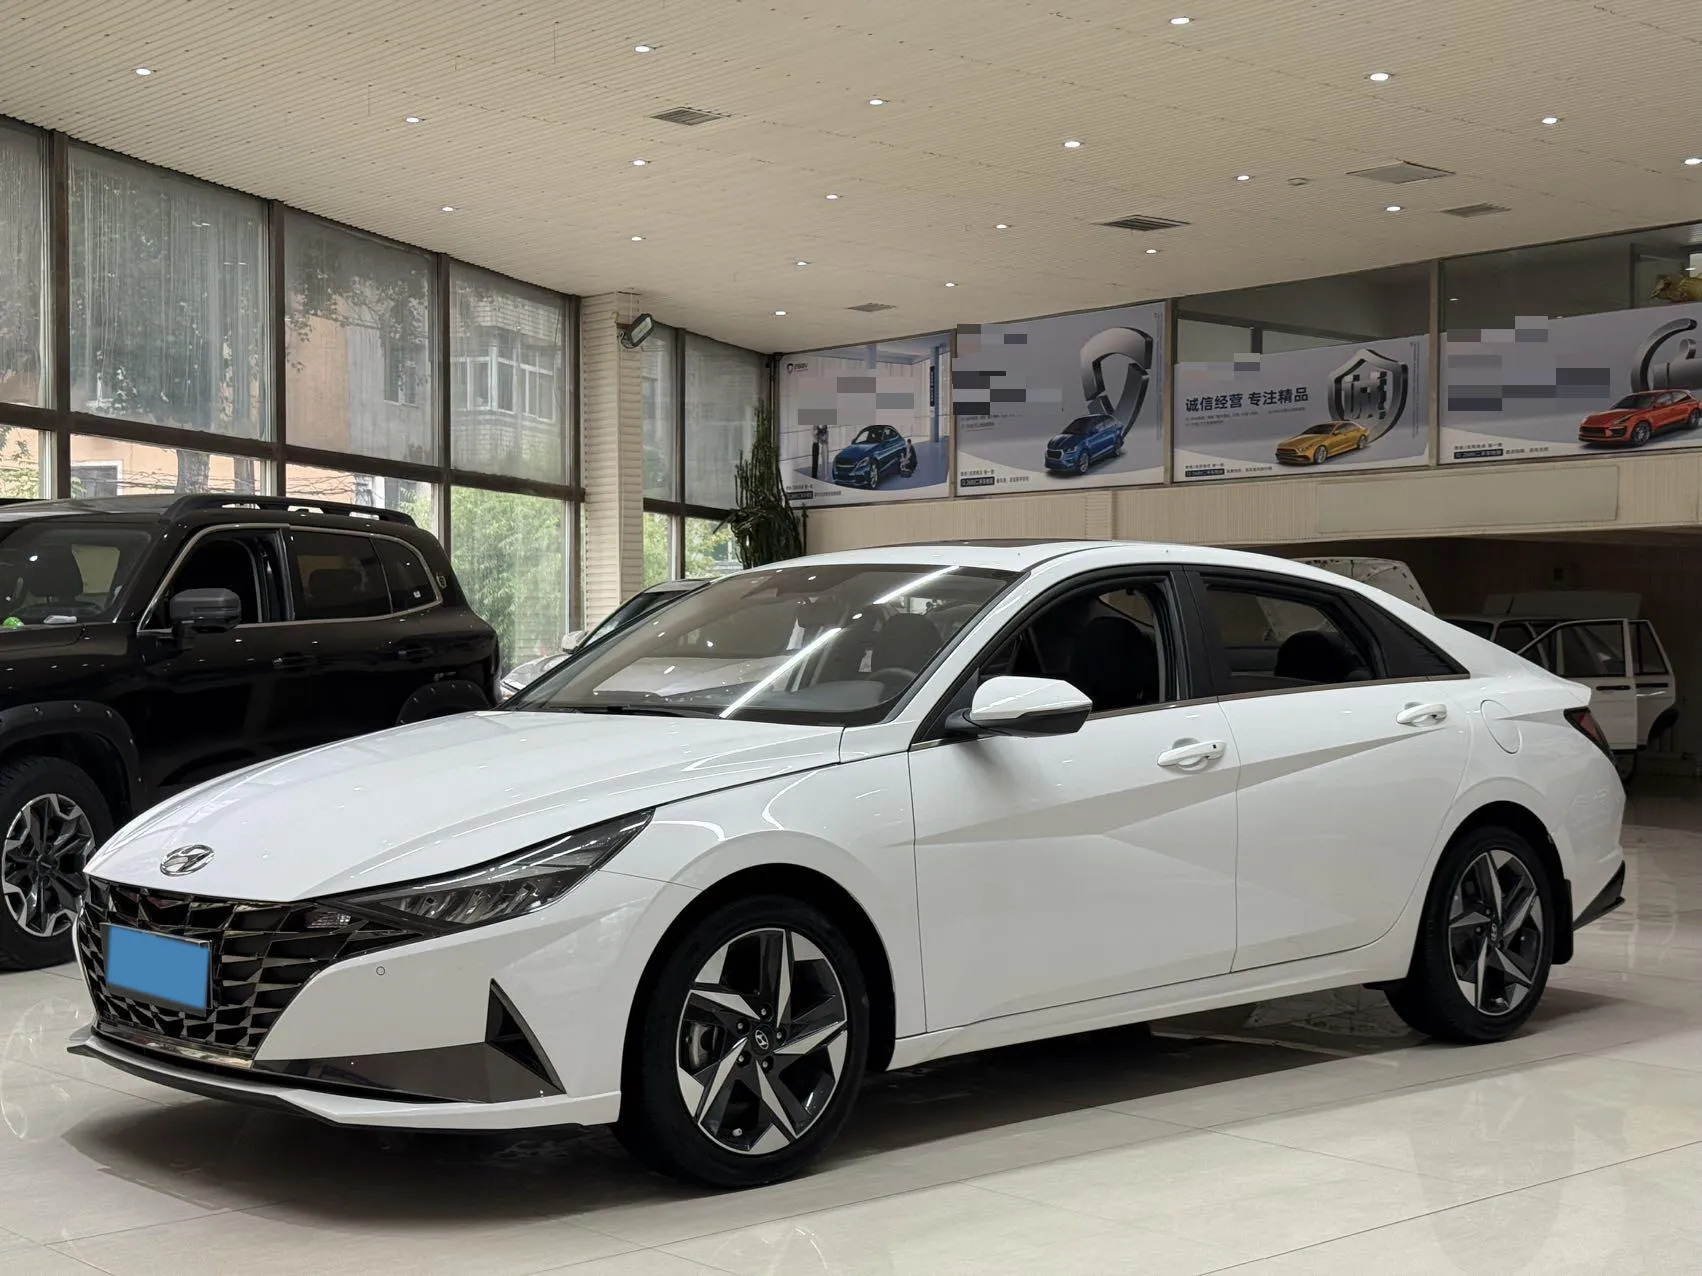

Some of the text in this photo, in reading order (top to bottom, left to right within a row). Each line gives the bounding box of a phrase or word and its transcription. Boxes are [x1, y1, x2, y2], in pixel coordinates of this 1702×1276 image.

[1185, 387, 1308, 412] 诚信经营 专注精品
